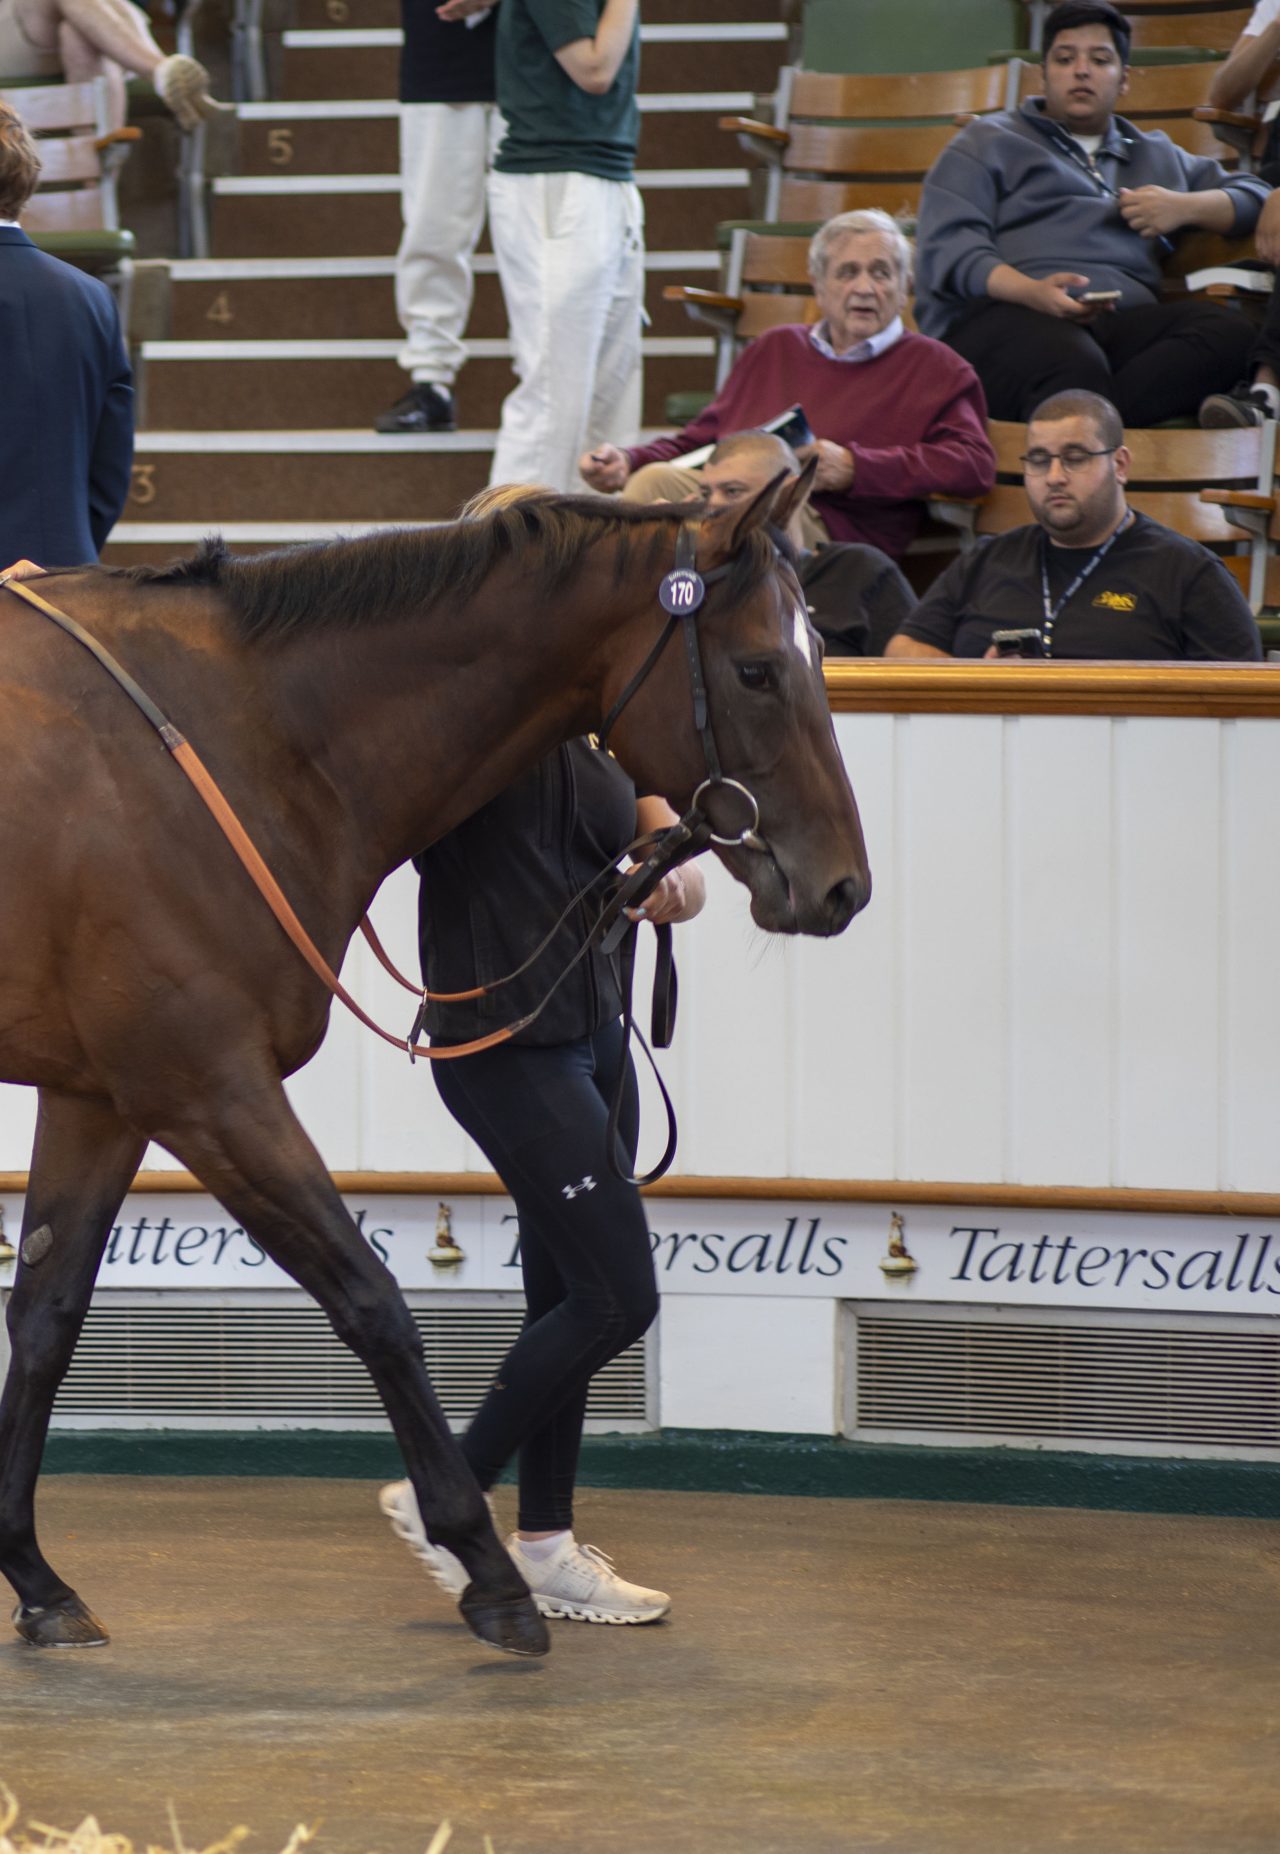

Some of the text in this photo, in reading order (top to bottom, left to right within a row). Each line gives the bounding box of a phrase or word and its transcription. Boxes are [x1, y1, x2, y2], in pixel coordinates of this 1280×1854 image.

[269, 129, 294, 164] 5
[206, 293, 234, 323] 4
[130, 464, 156, 503] 3
[670, 580, 694, 606] 170
